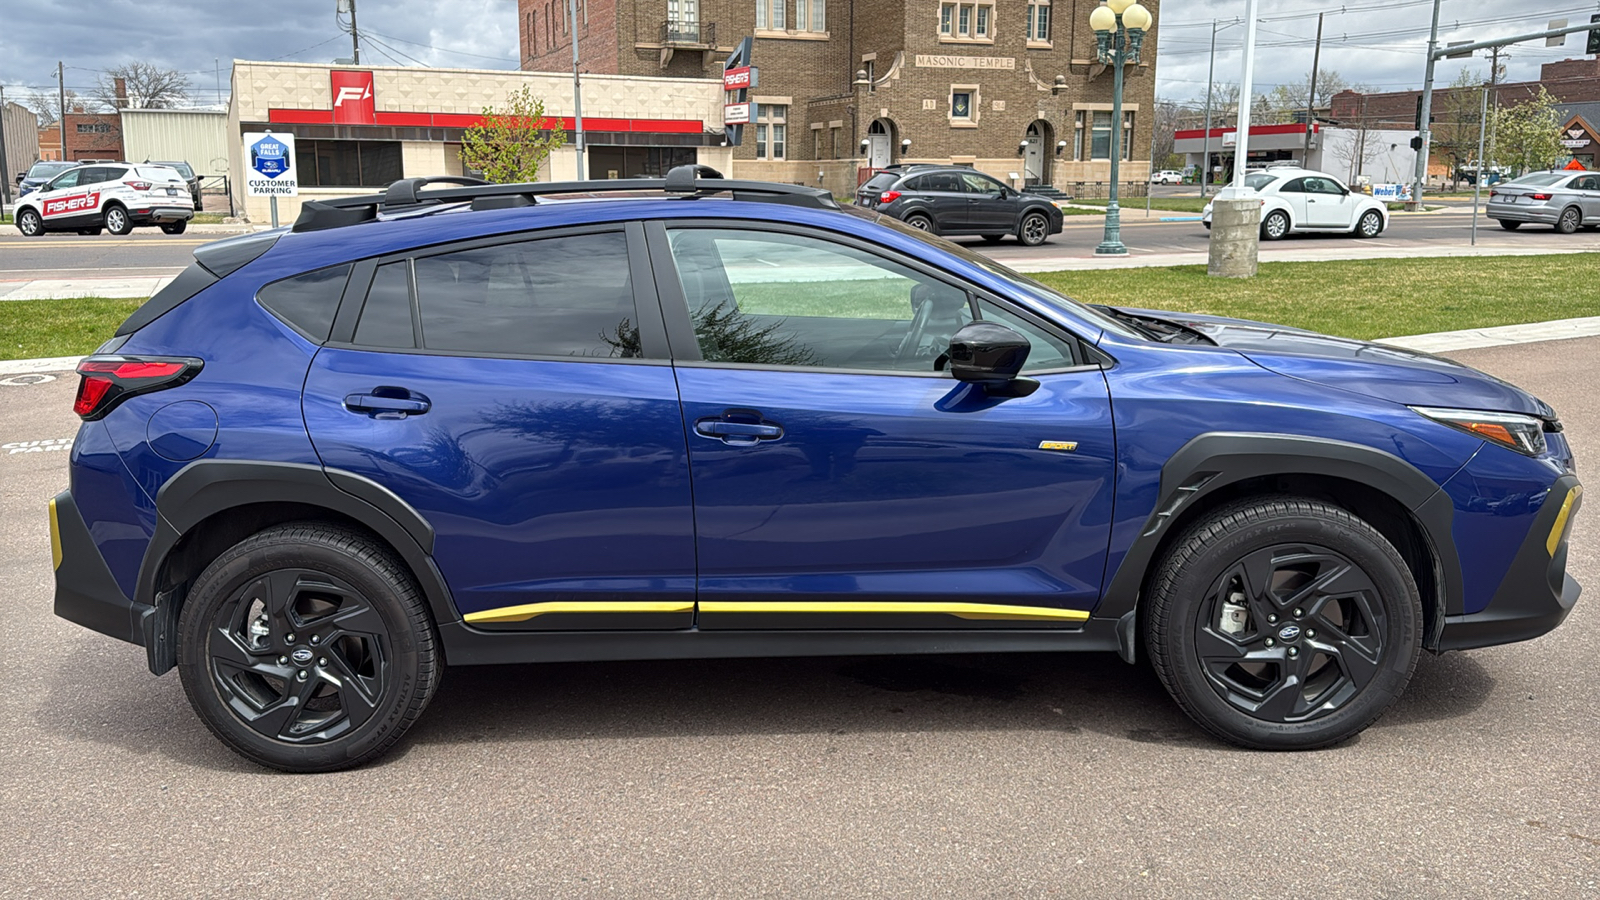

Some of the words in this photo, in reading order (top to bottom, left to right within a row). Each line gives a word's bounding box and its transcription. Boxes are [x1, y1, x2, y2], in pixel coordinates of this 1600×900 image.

[917, 56, 965, 67] MASONIC
[973, 57, 1014, 68] TEMPLE
[248, 179, 296, 187] CUSTOMER
[1374, 186, 1395, 196] Weber
[1, 438, 75, 449] CUST
[1041, 442, 1075, 450] SPORT
[1211, 528, 1262, 561] ALTIMAX
[387, 672, 411, 723] ALTIMAX
